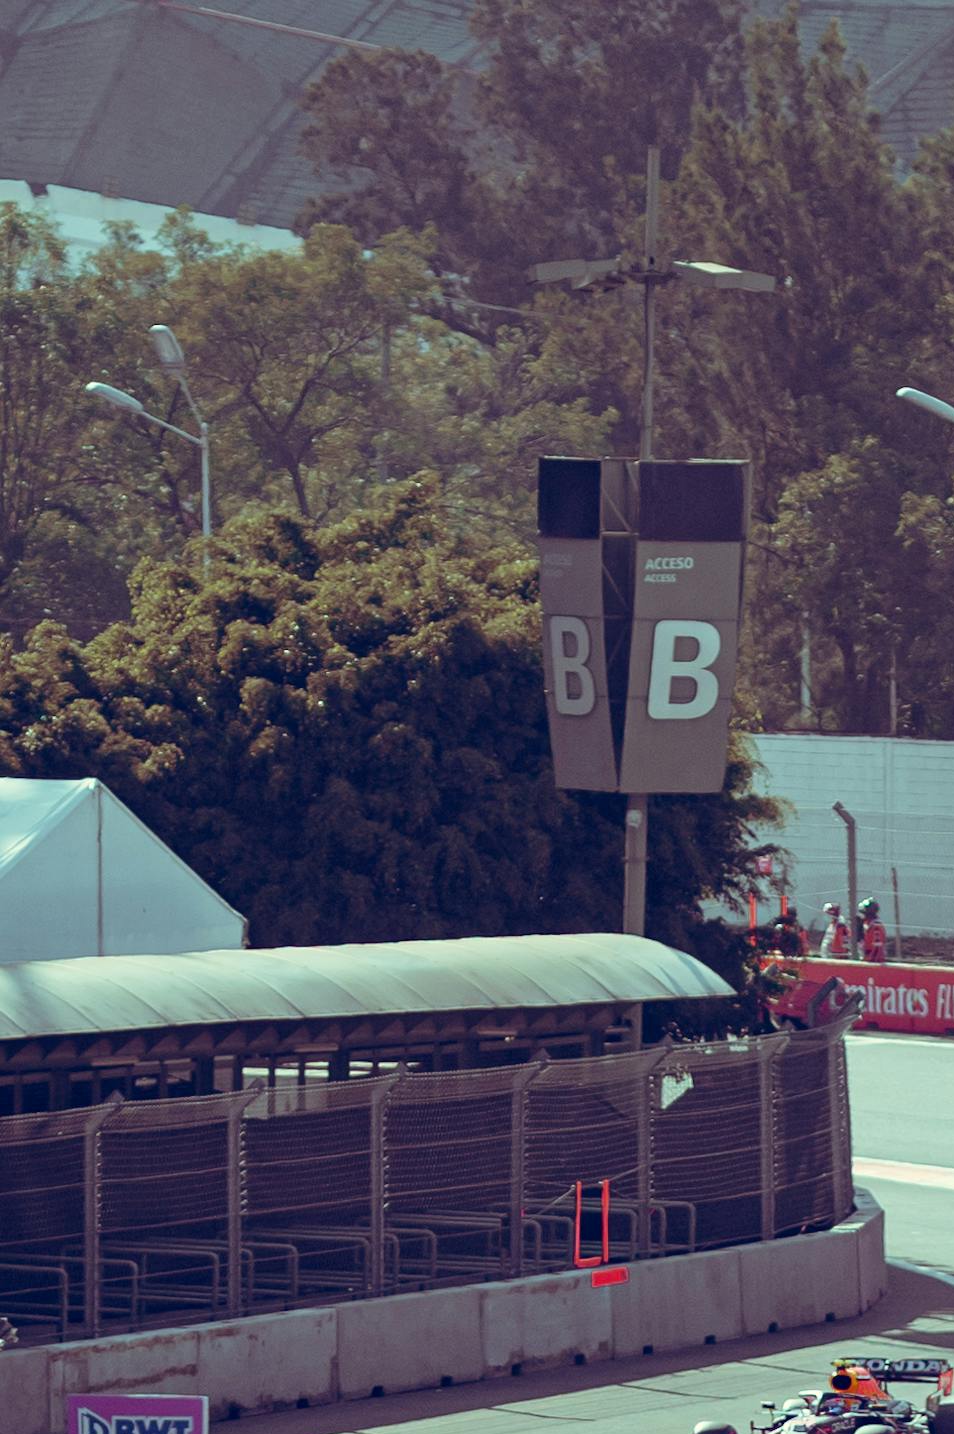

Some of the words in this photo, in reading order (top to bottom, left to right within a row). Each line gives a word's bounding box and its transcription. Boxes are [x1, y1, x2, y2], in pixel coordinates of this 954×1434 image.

[644, 557, 695, 571] ACCESO
[644, 573, 677, 583] ACCESS
[550, 616, 595, 716] B
[648, 619, 721, 720] B
